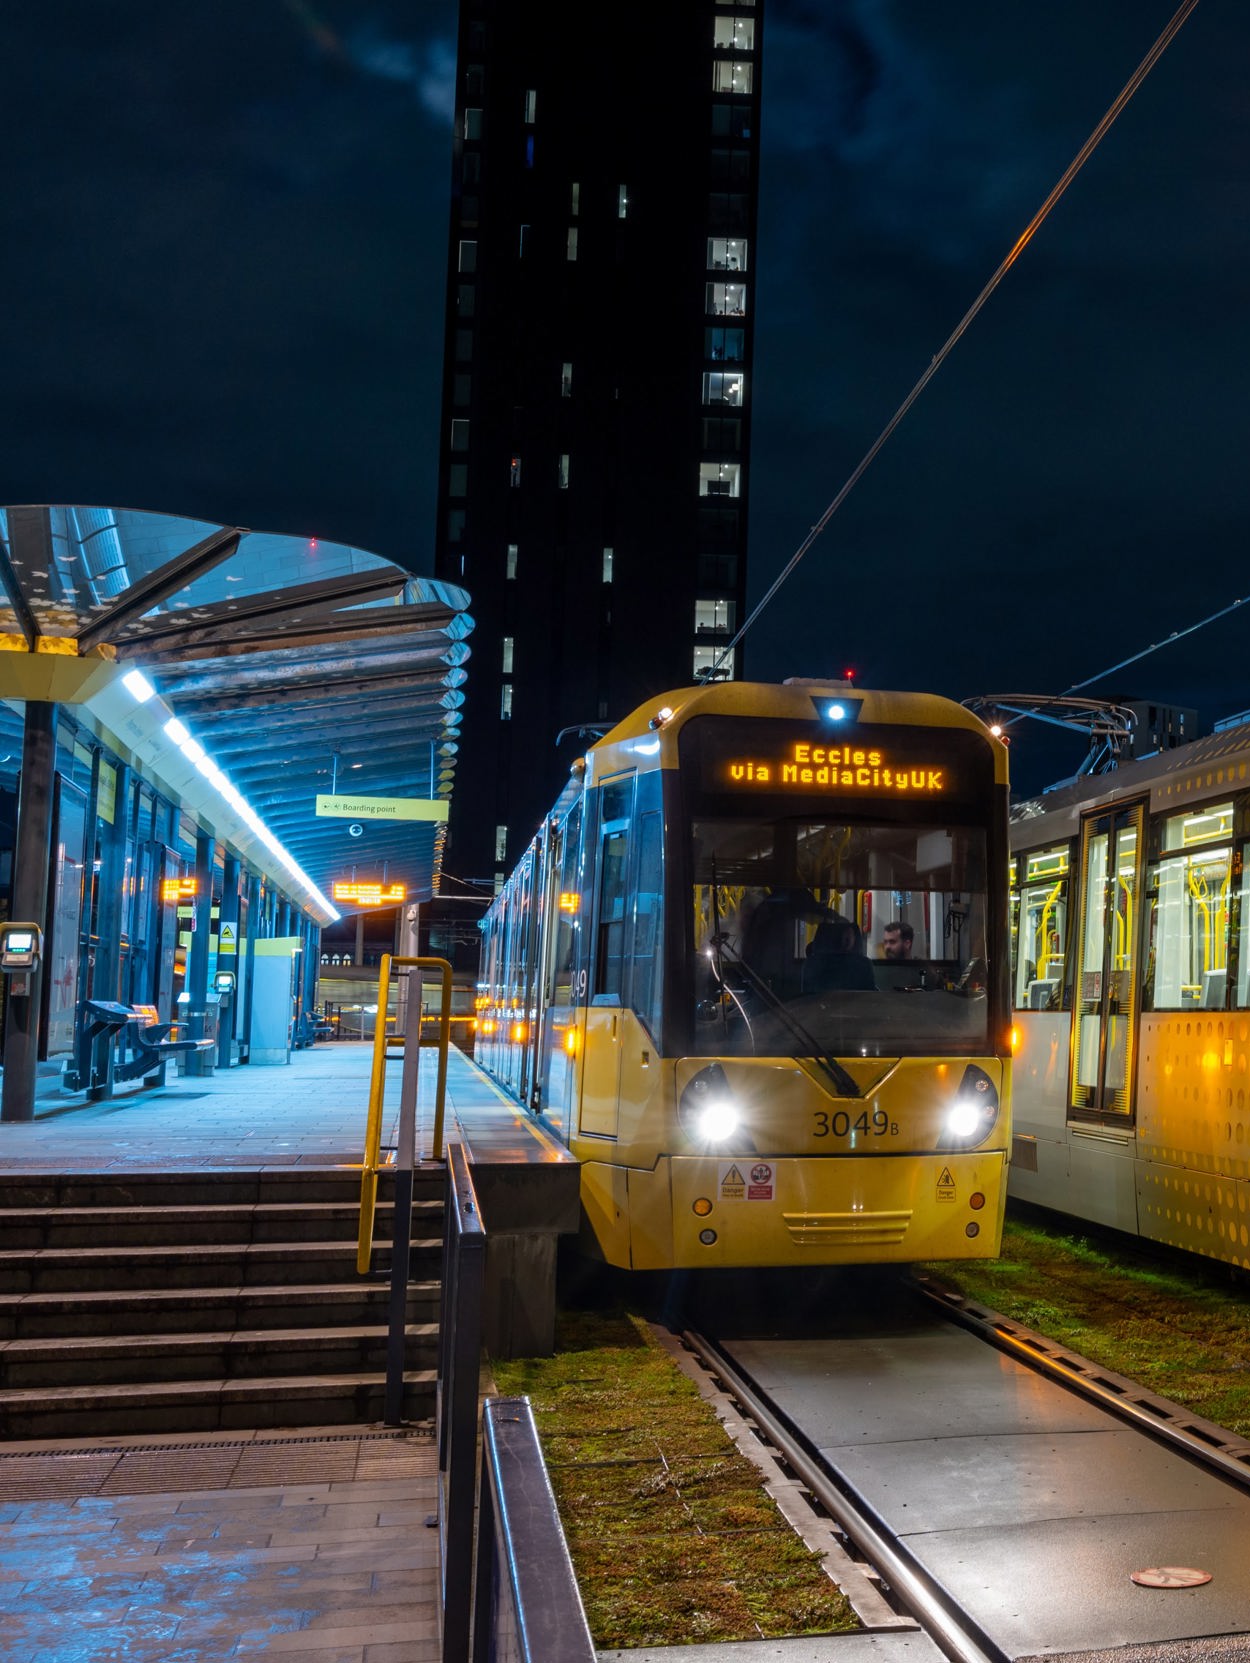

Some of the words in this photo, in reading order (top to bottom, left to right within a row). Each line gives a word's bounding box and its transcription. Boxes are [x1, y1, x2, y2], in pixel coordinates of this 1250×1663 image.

[795, 745, 881, 766] Eccles
[731, 763, 769, 781] via
[783, 764, 942, 789] MediaCityUK
[342, 804, 375, 814] Boarding
